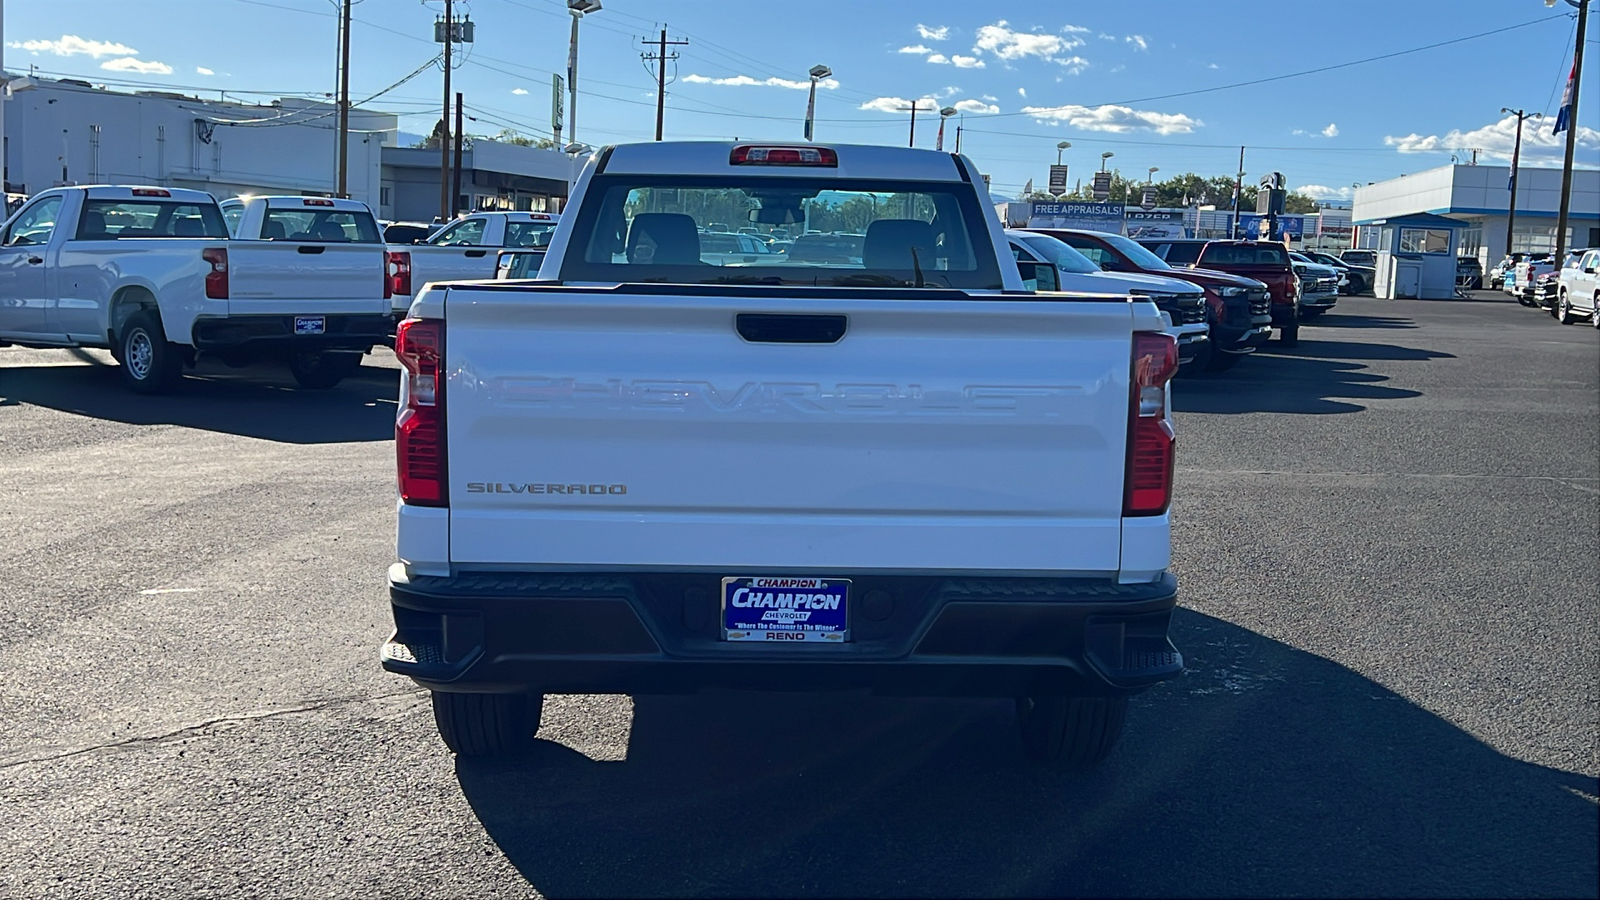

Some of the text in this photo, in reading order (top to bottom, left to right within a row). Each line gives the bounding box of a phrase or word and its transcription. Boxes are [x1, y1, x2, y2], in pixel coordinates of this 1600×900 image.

[1035, 205, 1122, 216] FREE APPRAISALS!
[466, 482, 628, 495] SILVERADO
[757, 579, 817, 588] CHAMPION
[732, 587, 842, 610] CHAMPION
[765, 612, 808, 620] CHEVROLET
[757, 622, 767, 630] The
[766, 632, 805, 640] RENO
